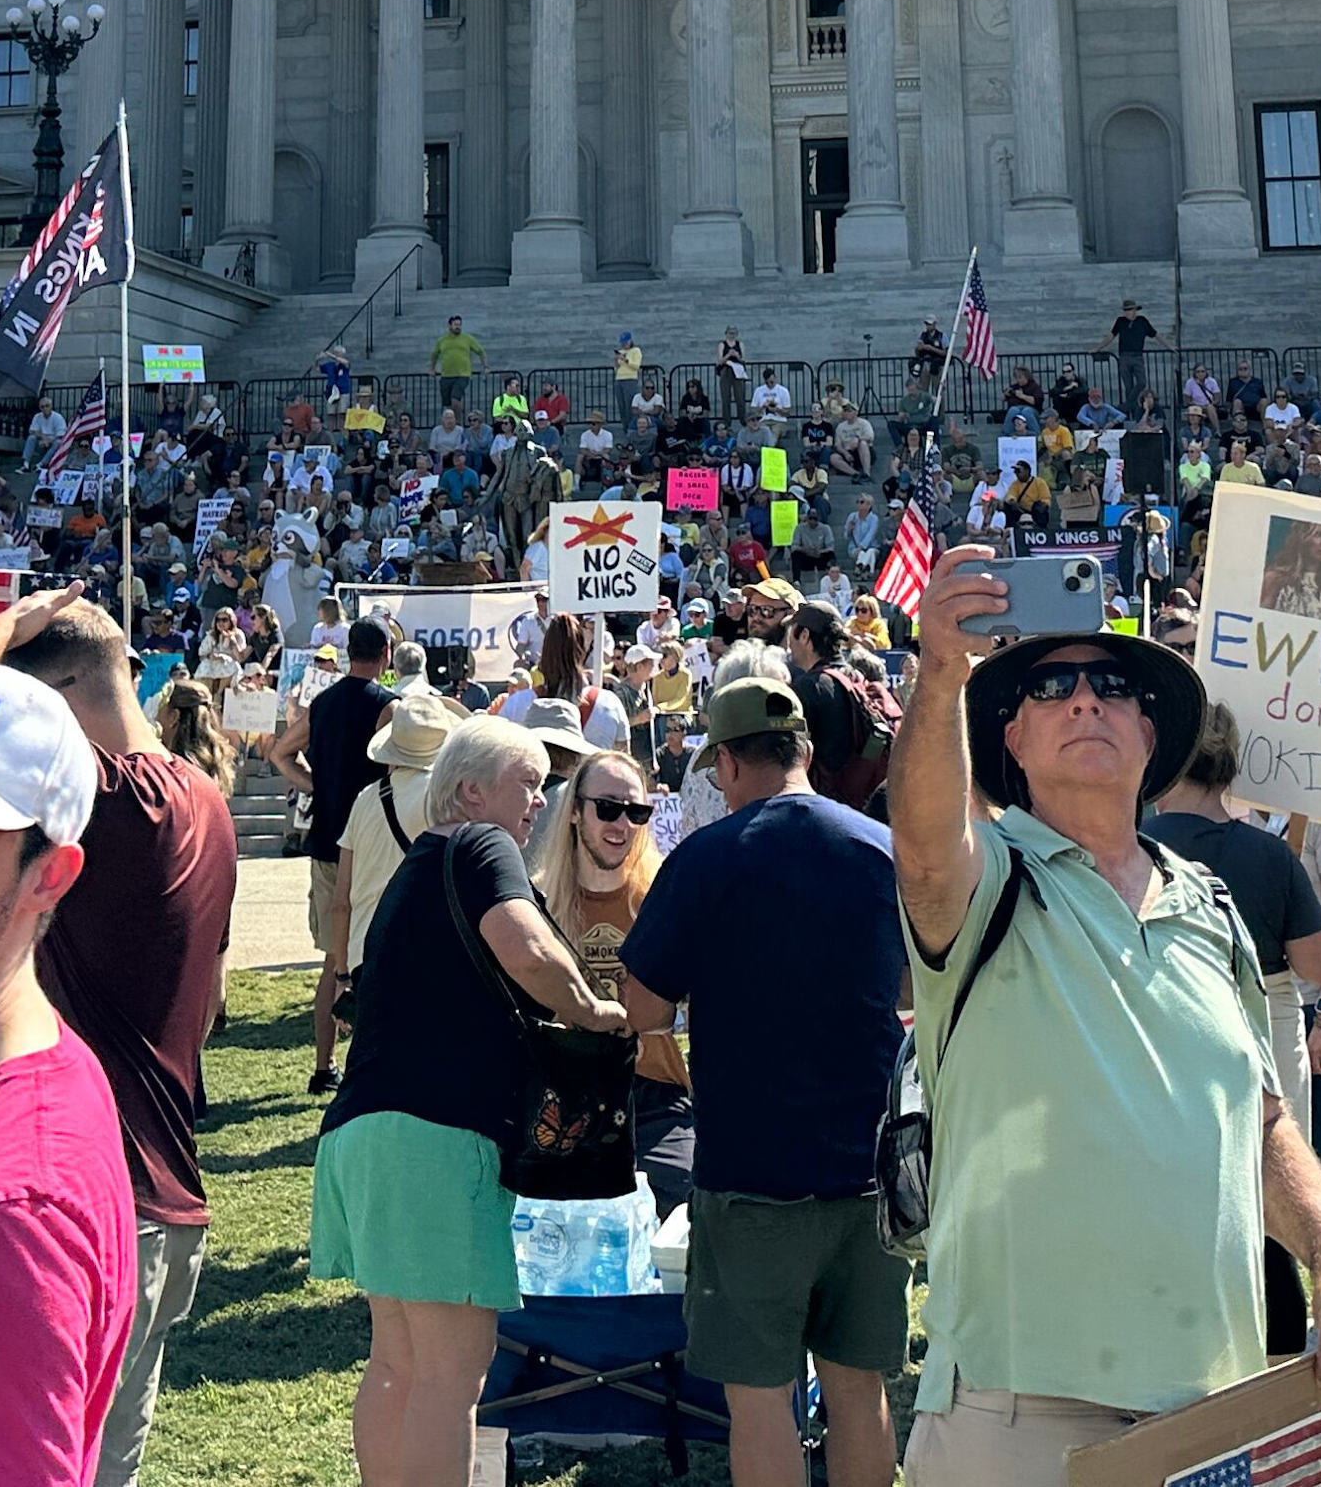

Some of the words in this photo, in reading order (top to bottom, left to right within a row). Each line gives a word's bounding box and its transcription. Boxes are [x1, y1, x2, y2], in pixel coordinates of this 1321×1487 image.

[1025, 532, 1047, 545] NO
[1056, 531, 1099, 544] KINGS
[1108, 528, 1122, 541] IN
[584, 545, 620, 572] NO
[578, 571, 637, 600] KINGS
[414, 627, 500, 650] 50501
